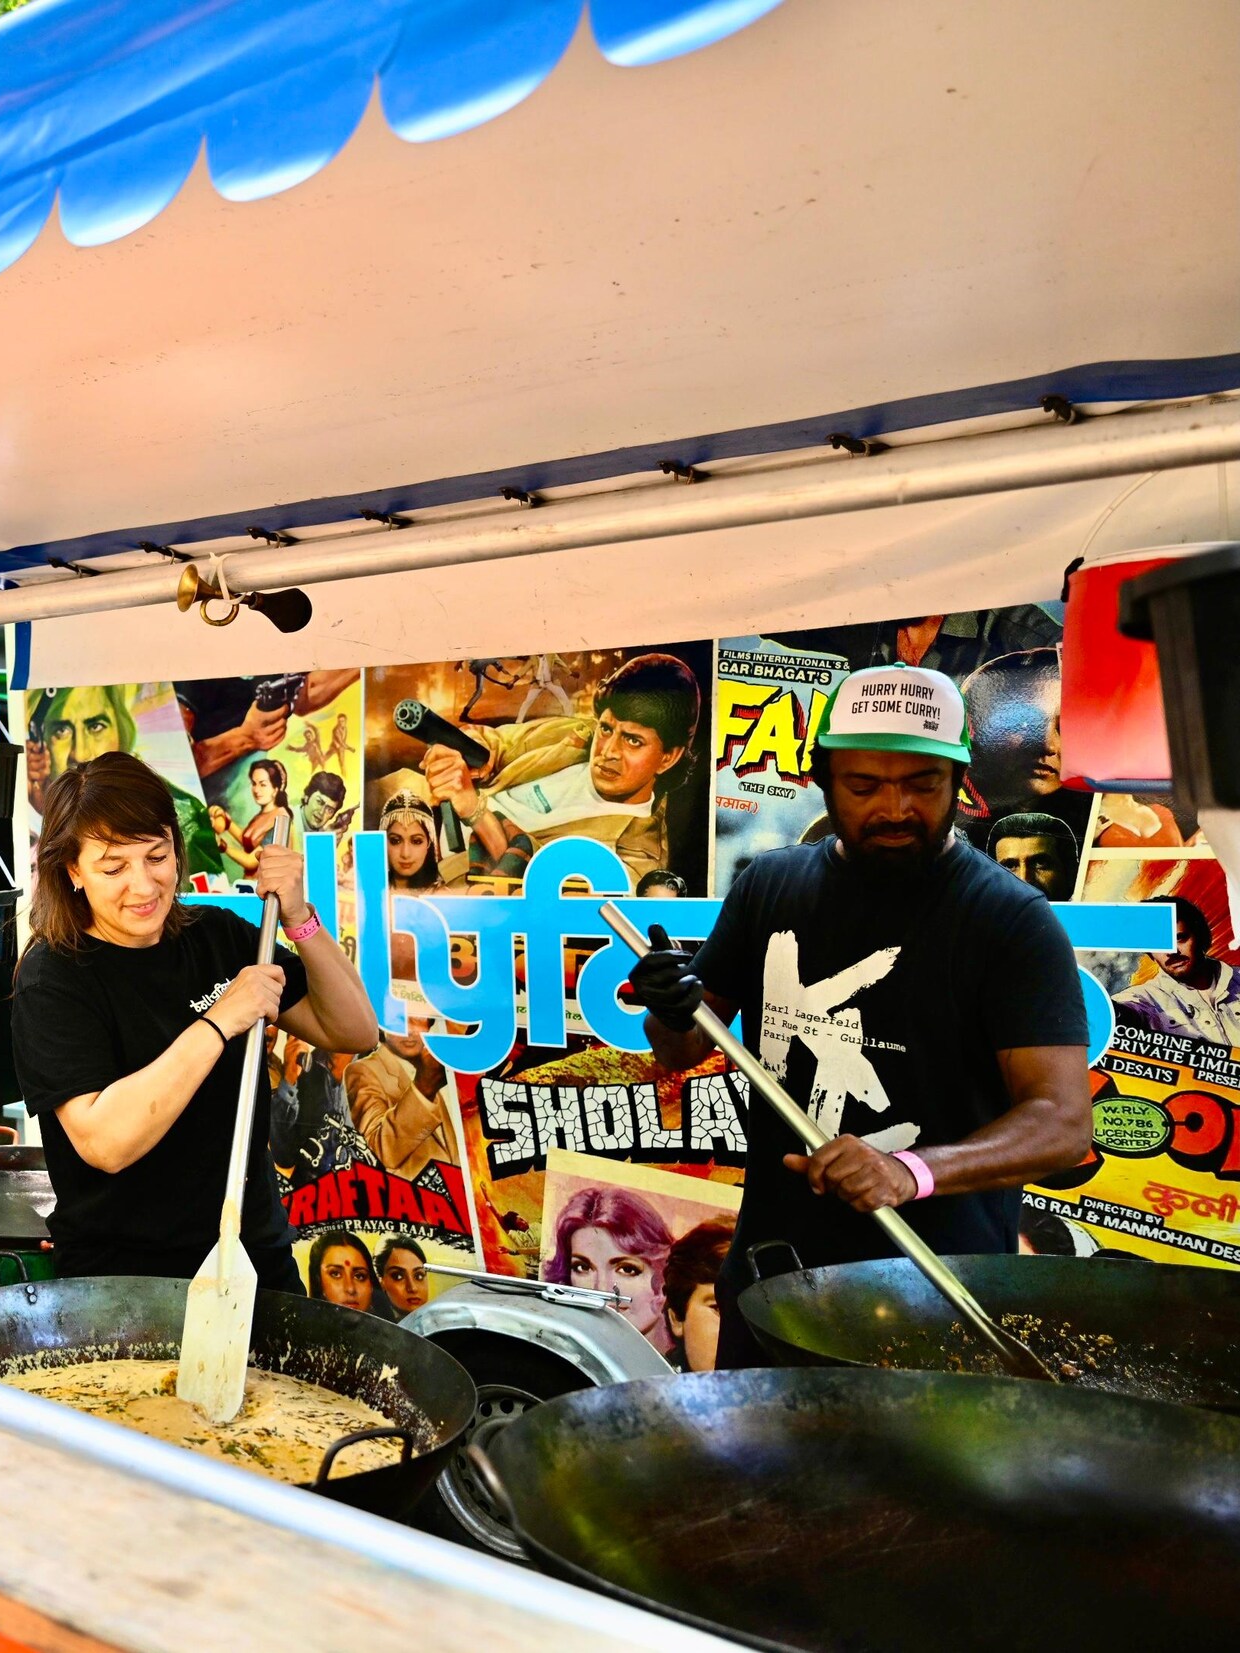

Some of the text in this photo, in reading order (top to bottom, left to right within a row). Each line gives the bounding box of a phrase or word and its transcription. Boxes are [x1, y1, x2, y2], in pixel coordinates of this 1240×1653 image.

[723, 650, 751, 661] FILMS
[753, 653, 842, 670] INTERNATIONAL'S
[754, 665, 831, 683] BHAGAT'S
[861, 683, 935, 700] HURRY HURRY
[852, 700, 941, 720] GET SOME CURRY!
[764, 1002, 860, 1030] Karl Lagerfeld
[763, 1016, 777, 1026] 21
[781, 1019, 799, 1032] Rue
[803, 1025, 818, 1037] St
[840, 1033, 907, 1053] Guillaume
[763, 1029, 791, 1044] Paris
[1115, 1024, 1228, 1059] COMBINE AND
[1111, 1037, 1185, 1063] PRIVATE
[1112, 1058, 1173, 1083] DESAI'S
[1095, 1128, 1160, 1139] LICENSED
[1084, 1199, 1162, 1225] DIRECTED BY
[344, 1219, 395, 1232] PRAYAG
[400, 1222, 434, 1238] RAAJ
[1050, 1200, 1083, 1218] RAJ
[1085, 1210, 1100, 1223] &
[1104, 1216, 1208, 1252] MANMOHAN
